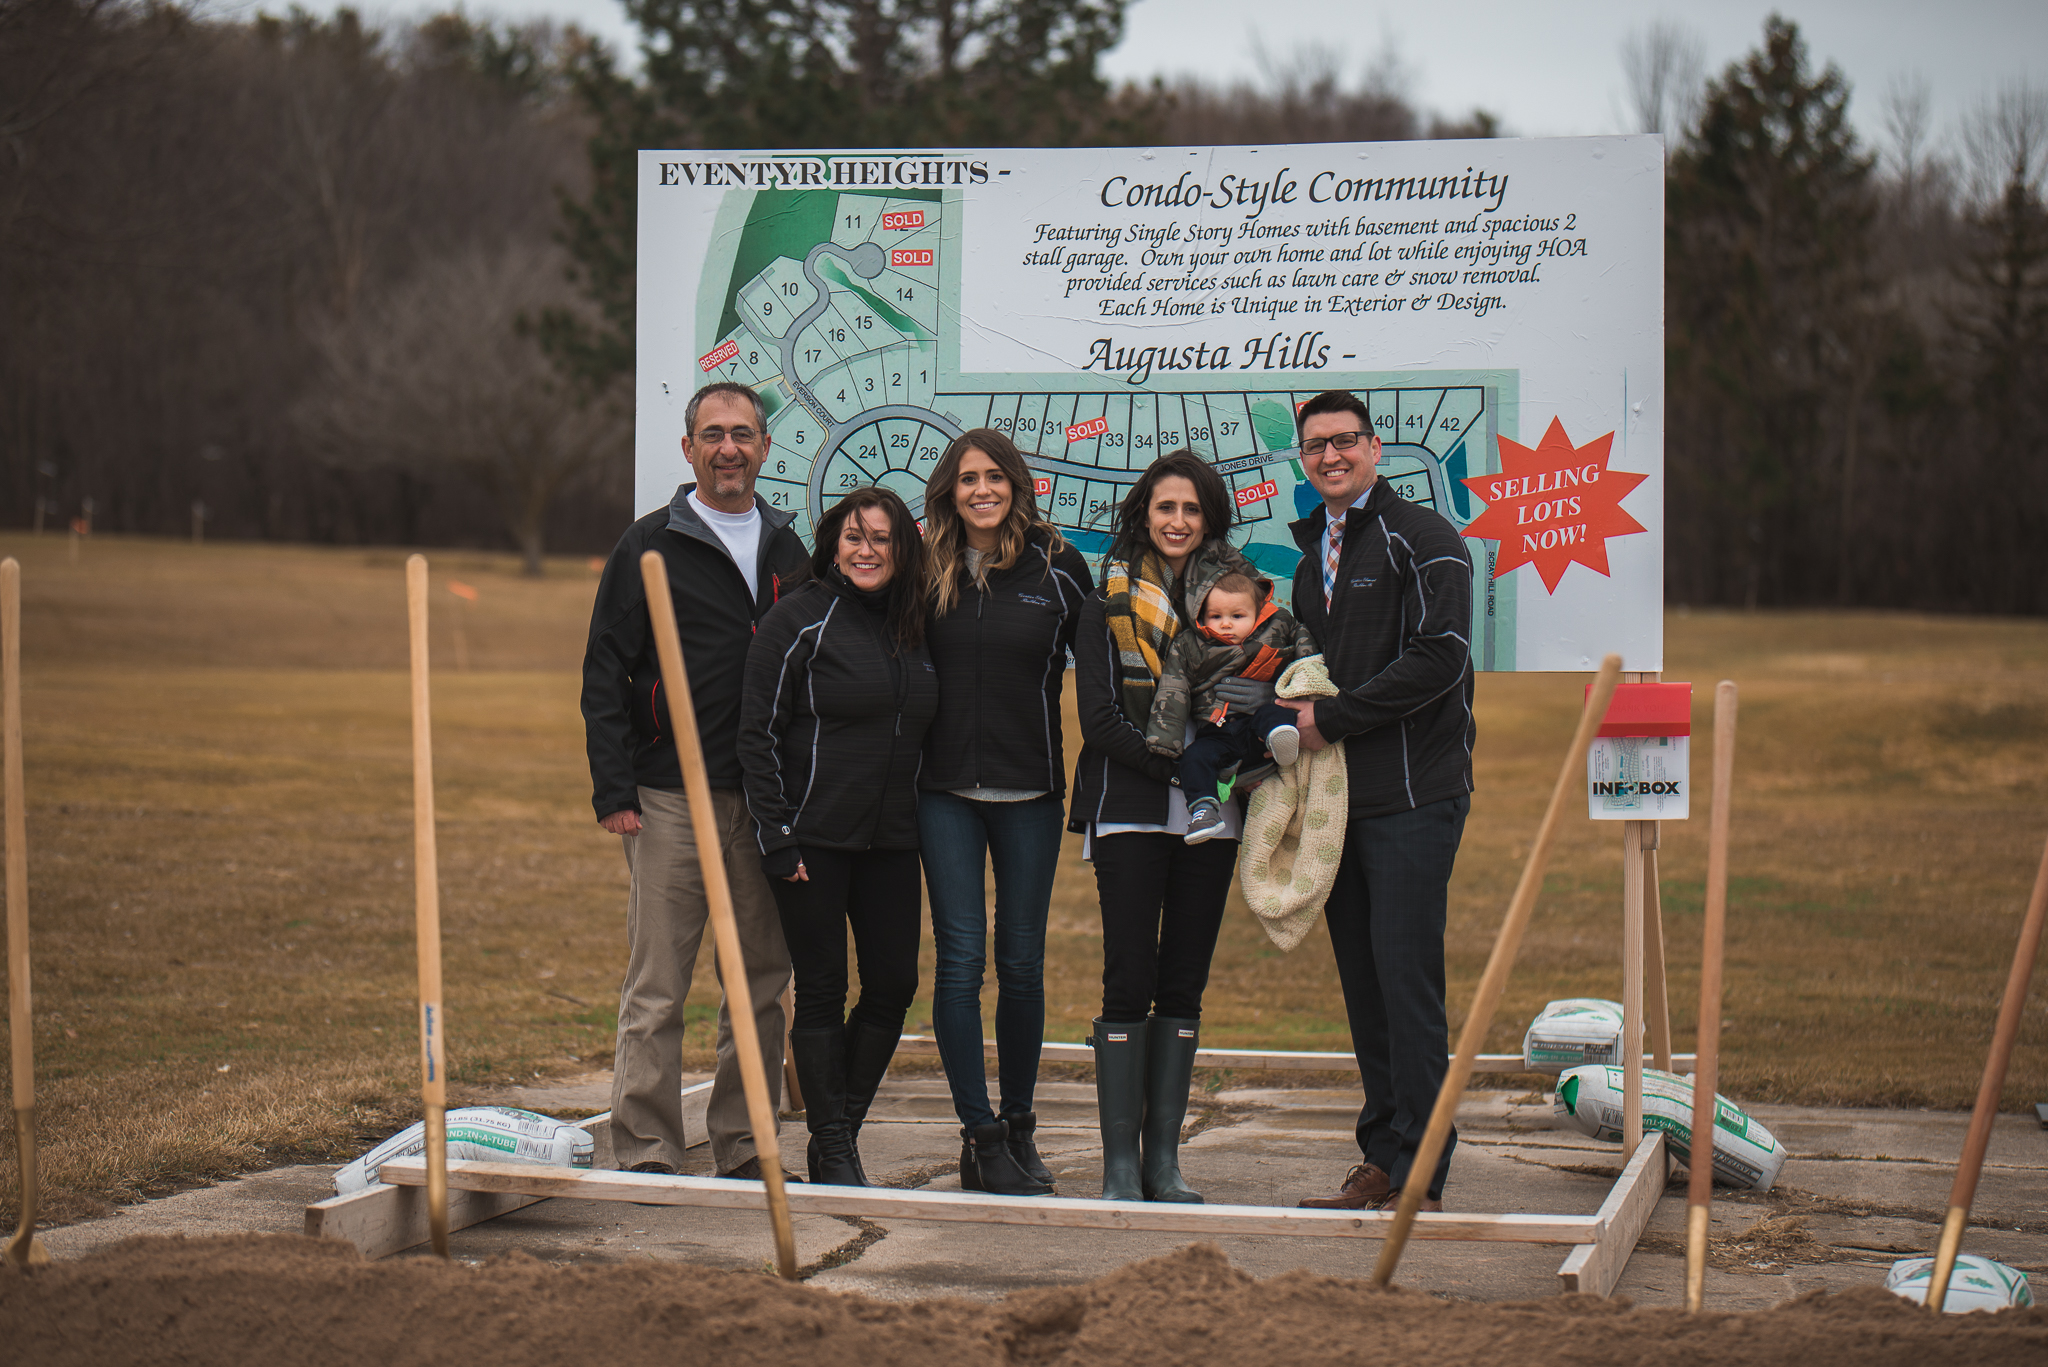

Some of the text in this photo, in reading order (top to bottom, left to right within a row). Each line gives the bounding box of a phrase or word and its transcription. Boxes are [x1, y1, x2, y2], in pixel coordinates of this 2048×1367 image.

[658, 162, 832, 186] EVENTYR
[833, 160, 989, 186] HEIGHTS
[1100, 166, 1509, 219] Condo-Style Community
[845, 214, 861, 229] 11
[883, 213, 922, 227] SOLD
[1032, 212, 1577, 249] Featuring Single Story Homes with basement and spacious 2
[893, 251, 931, 264] SOLD
[1022, 236, 1588, 274] stall garage. Own your own home and lot while enjoying HOA
[1063, 263, 1541, 298] provided services such as lawn care & snow removal.
[781, 282, 799, 297] 10
[896, 287, 914, 302] 14
[763, 301, 773, 317] 9
[1098, 291, 1507, 321] Each Home is Unique in Exterior & Design.
[855, 315, 873, 330] 15
[828, 329, 846, 343] 16
[699, 342, 738, 371] RESERVED
[749, 350, 759, 365] 8
[804, 349, 822, 364] 17
[1081, 337, 1232, 385] Augusta
[1239, 331, 1331, 370] Hills
[729, 362, 739, 377] 7
[920, 369, 927, 384] 1
[864, 377, 875, 392] 3
[891, 372, 902, 387] 2
[836, 388, 846, 403] 4
[792, 380, 836, 428] EVERSON COURT
[993, 417, 1013, 432] 29
[1017, 417, 1037, 432] 30
[1045, 420, 1062, 436] 31
[1067, 419, 1106, 440] SOLD
[1220, 421, 1240, 436] 37
[1374, 414, 1395, 430] 40
[1405, 414, 1425, 430] 41
[1439, 417, 1460, 432] 42
[795, 430, 805, 445] 5
[890, 433, 910, 449] 25
[1105, 432, 1125, 448] 33
[1134, 434, 1154, 449] 34
[1160, 431, 1180, 445] 35
[1190, 426, 1210, 442] 36
[858, 444, 878, 460] 24
[919, 446, 940, 461] 26
[776, 460, 786, 475] 6
[1220, 459, 1248, 472] JONES
[1248, 453, 1274, 467] DRIVE
[839, 473, 859, 487] 23
[1489, 463, 1600, 501] SELLING
[771, 491, 789, 506] 21
[1236, 482, 1275, 504] SOLD
[1394, 484, 1416, 499] 43
[1058, 492, 1078, 507] 55
[1089, 499, 1109, 514] 54
[1516, 495, 1582, 526] LOTS
[1521, 523, 1587, 554] NOW!
[1487, 577, 1495, 593] HILL
[1487, 594, 1495, 617] ROAD
